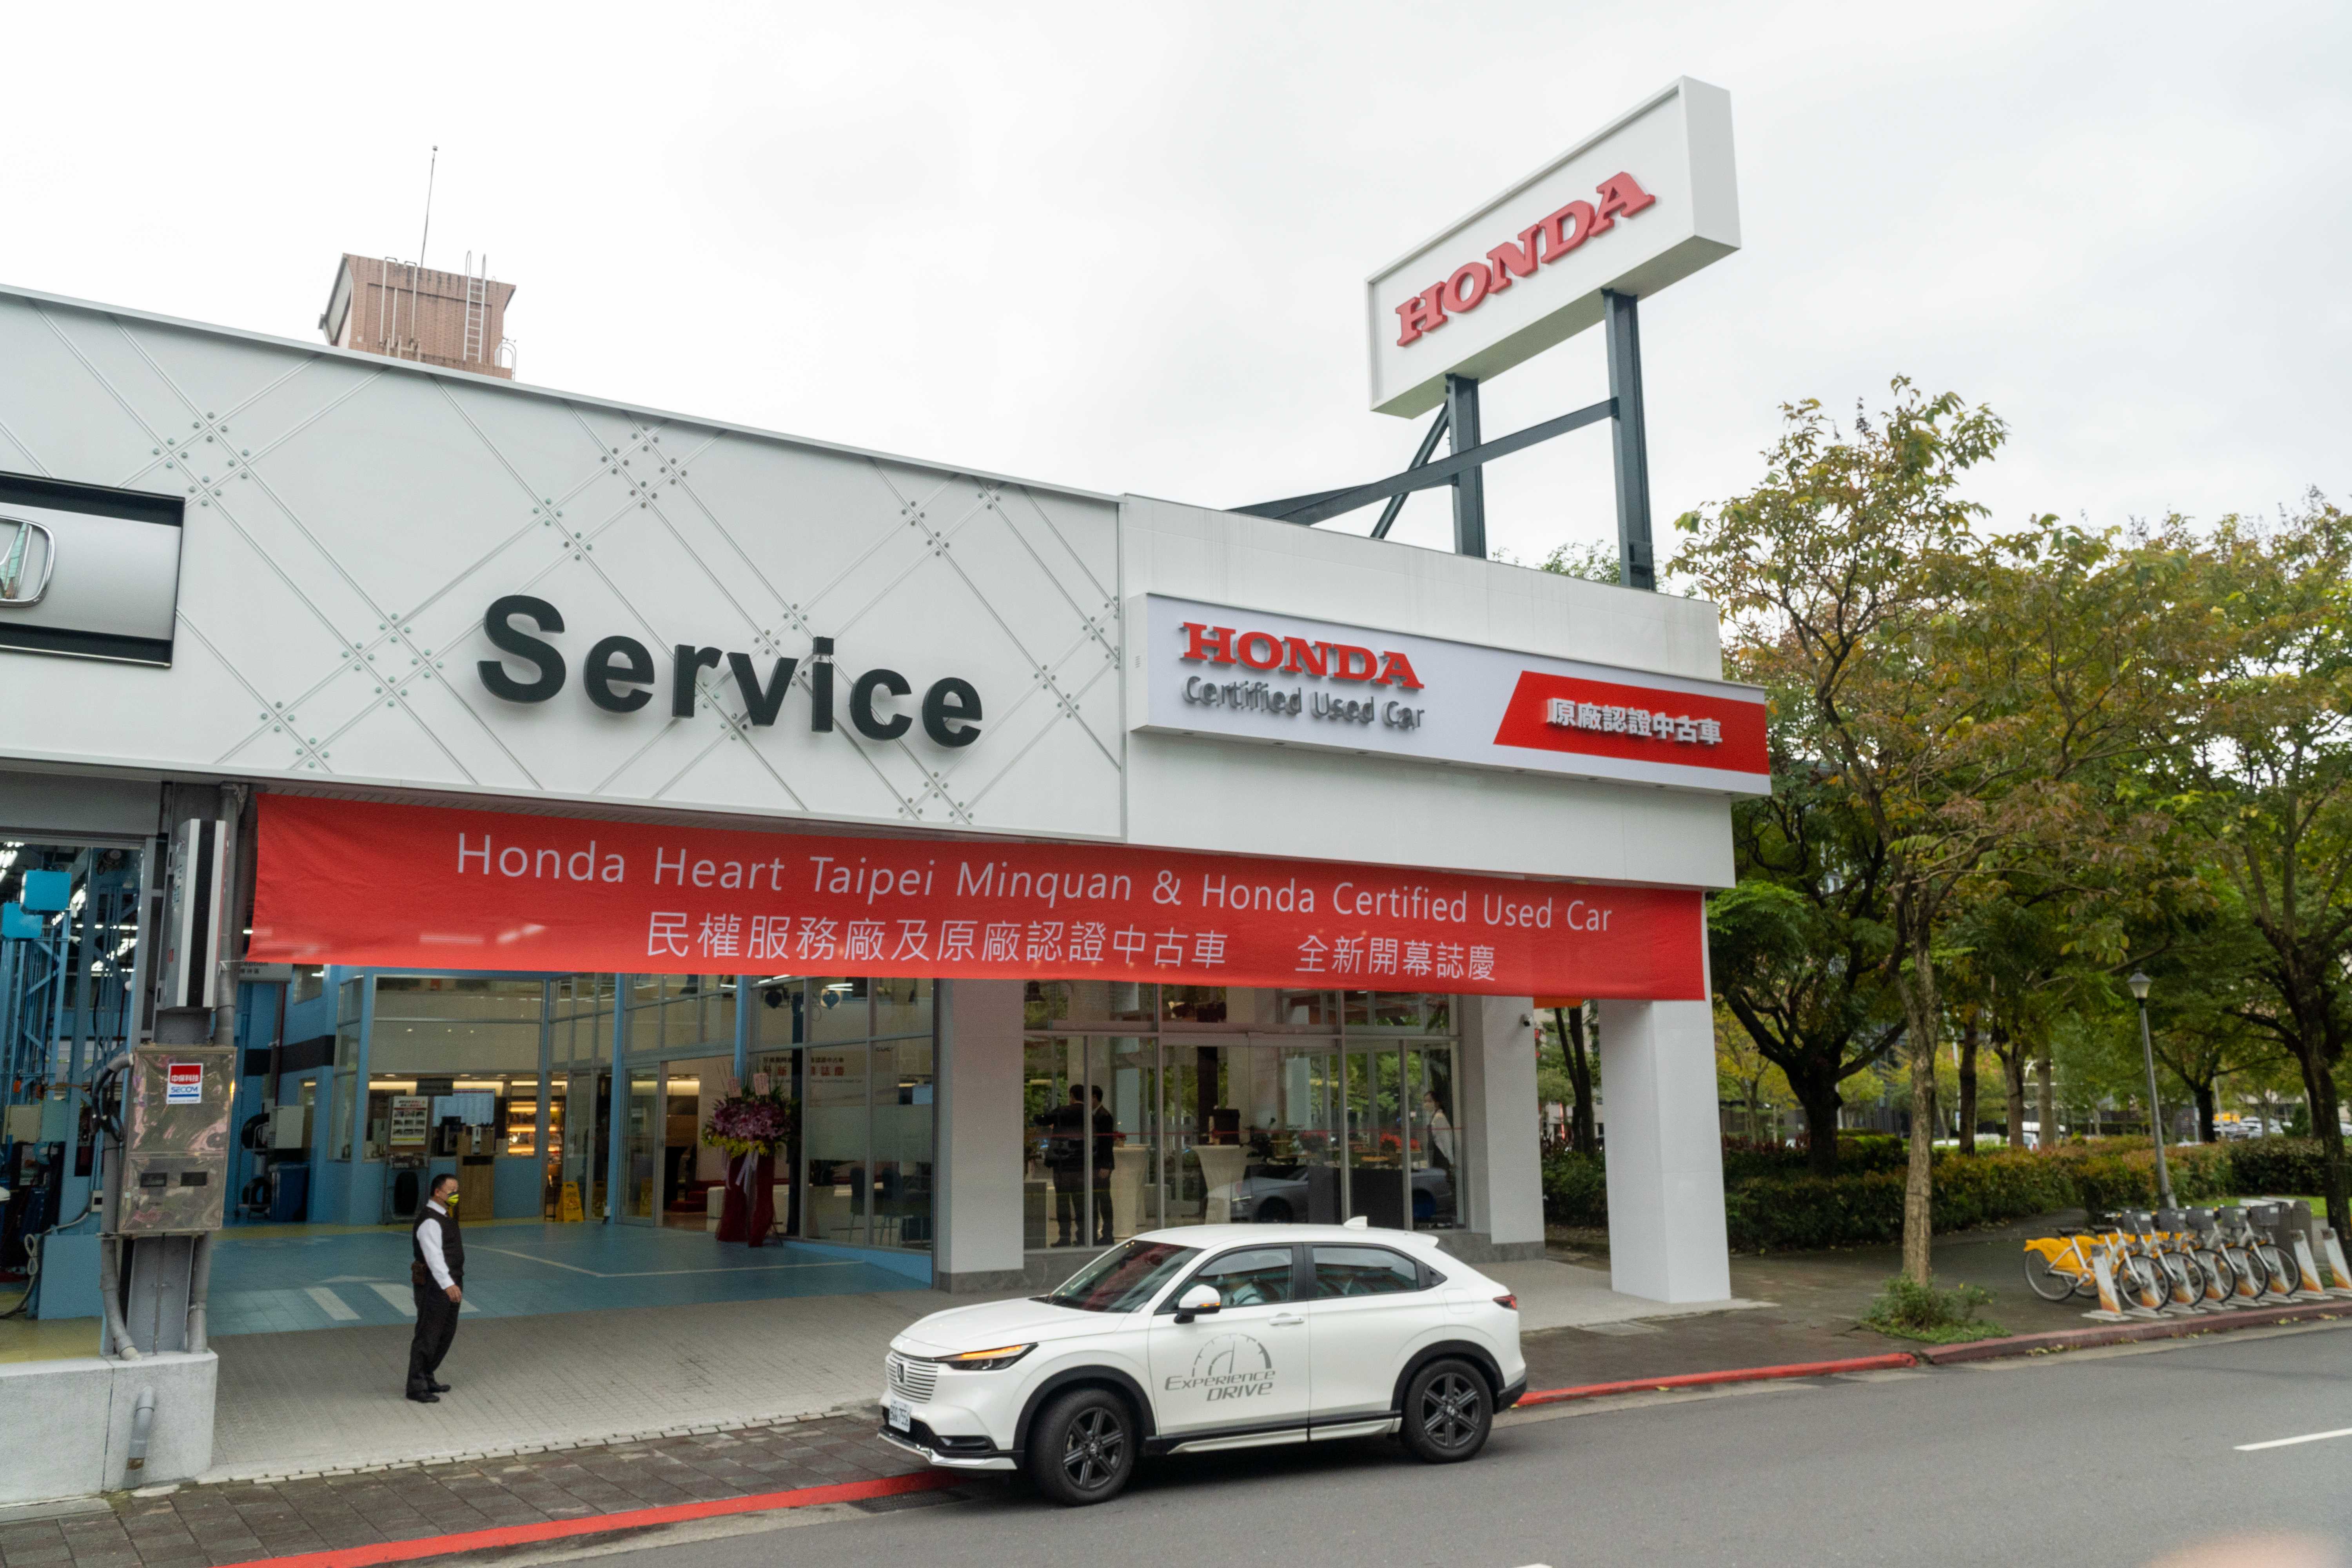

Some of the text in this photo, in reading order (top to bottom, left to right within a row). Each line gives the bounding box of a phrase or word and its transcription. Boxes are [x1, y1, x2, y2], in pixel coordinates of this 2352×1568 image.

[1396, 171, 1655, 347] HONDA
[477, 595, 983, 748] Service
[1180, 622, 1425, 690] HONDA
[1182, 676, 1425, 729] Certified Used Car
[1546, 697, 1723, 744] 原廠認證中古車
[457, 833, 1612, 931] Honda Heart Taipei Minquan & Honda Certified Used Car
[647, 912, 1495, 981] 民權服務廠及原廠認證中古車 全新開幕誌慶
